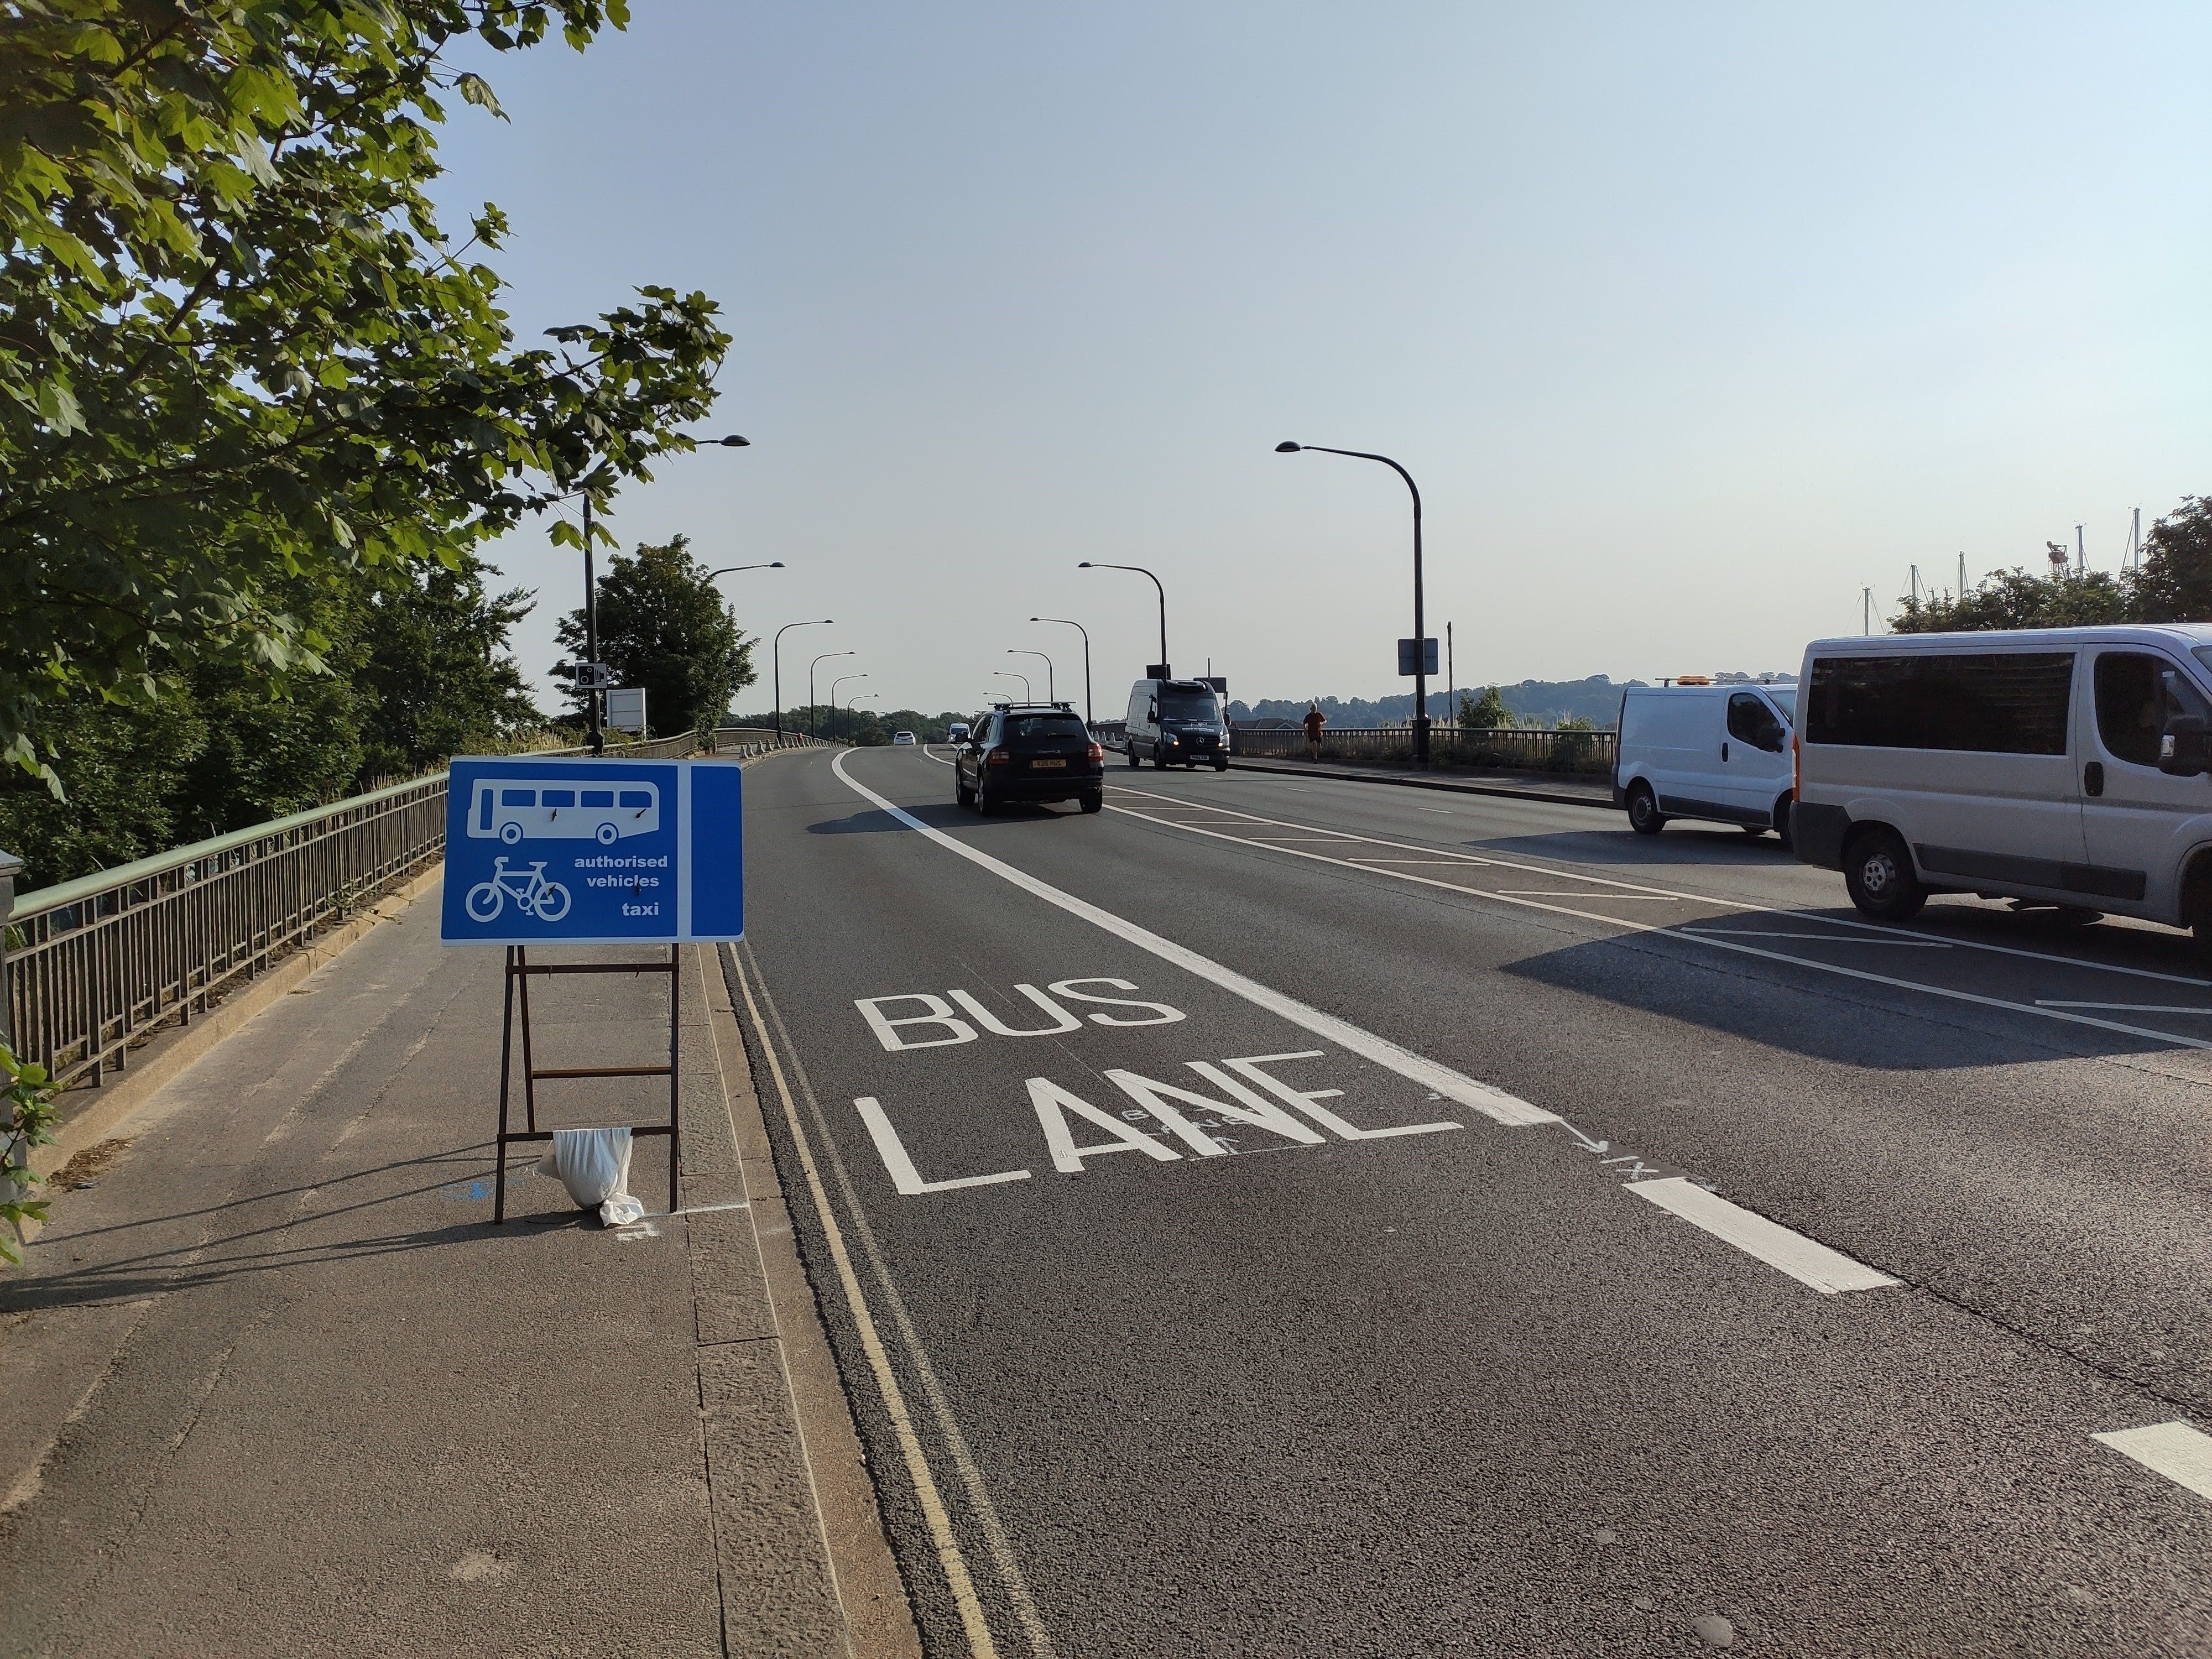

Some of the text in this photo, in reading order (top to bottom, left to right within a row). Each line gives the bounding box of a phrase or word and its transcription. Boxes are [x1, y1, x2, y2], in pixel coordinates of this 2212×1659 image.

[575, 855, 667, 868] authorised
[587, 875, 659, 887] vehicles
[622, 902, 659, 916] taxi
[854, 978, 1186, 1051] BUS
[853, 1050, 1464, 1195] LANE
